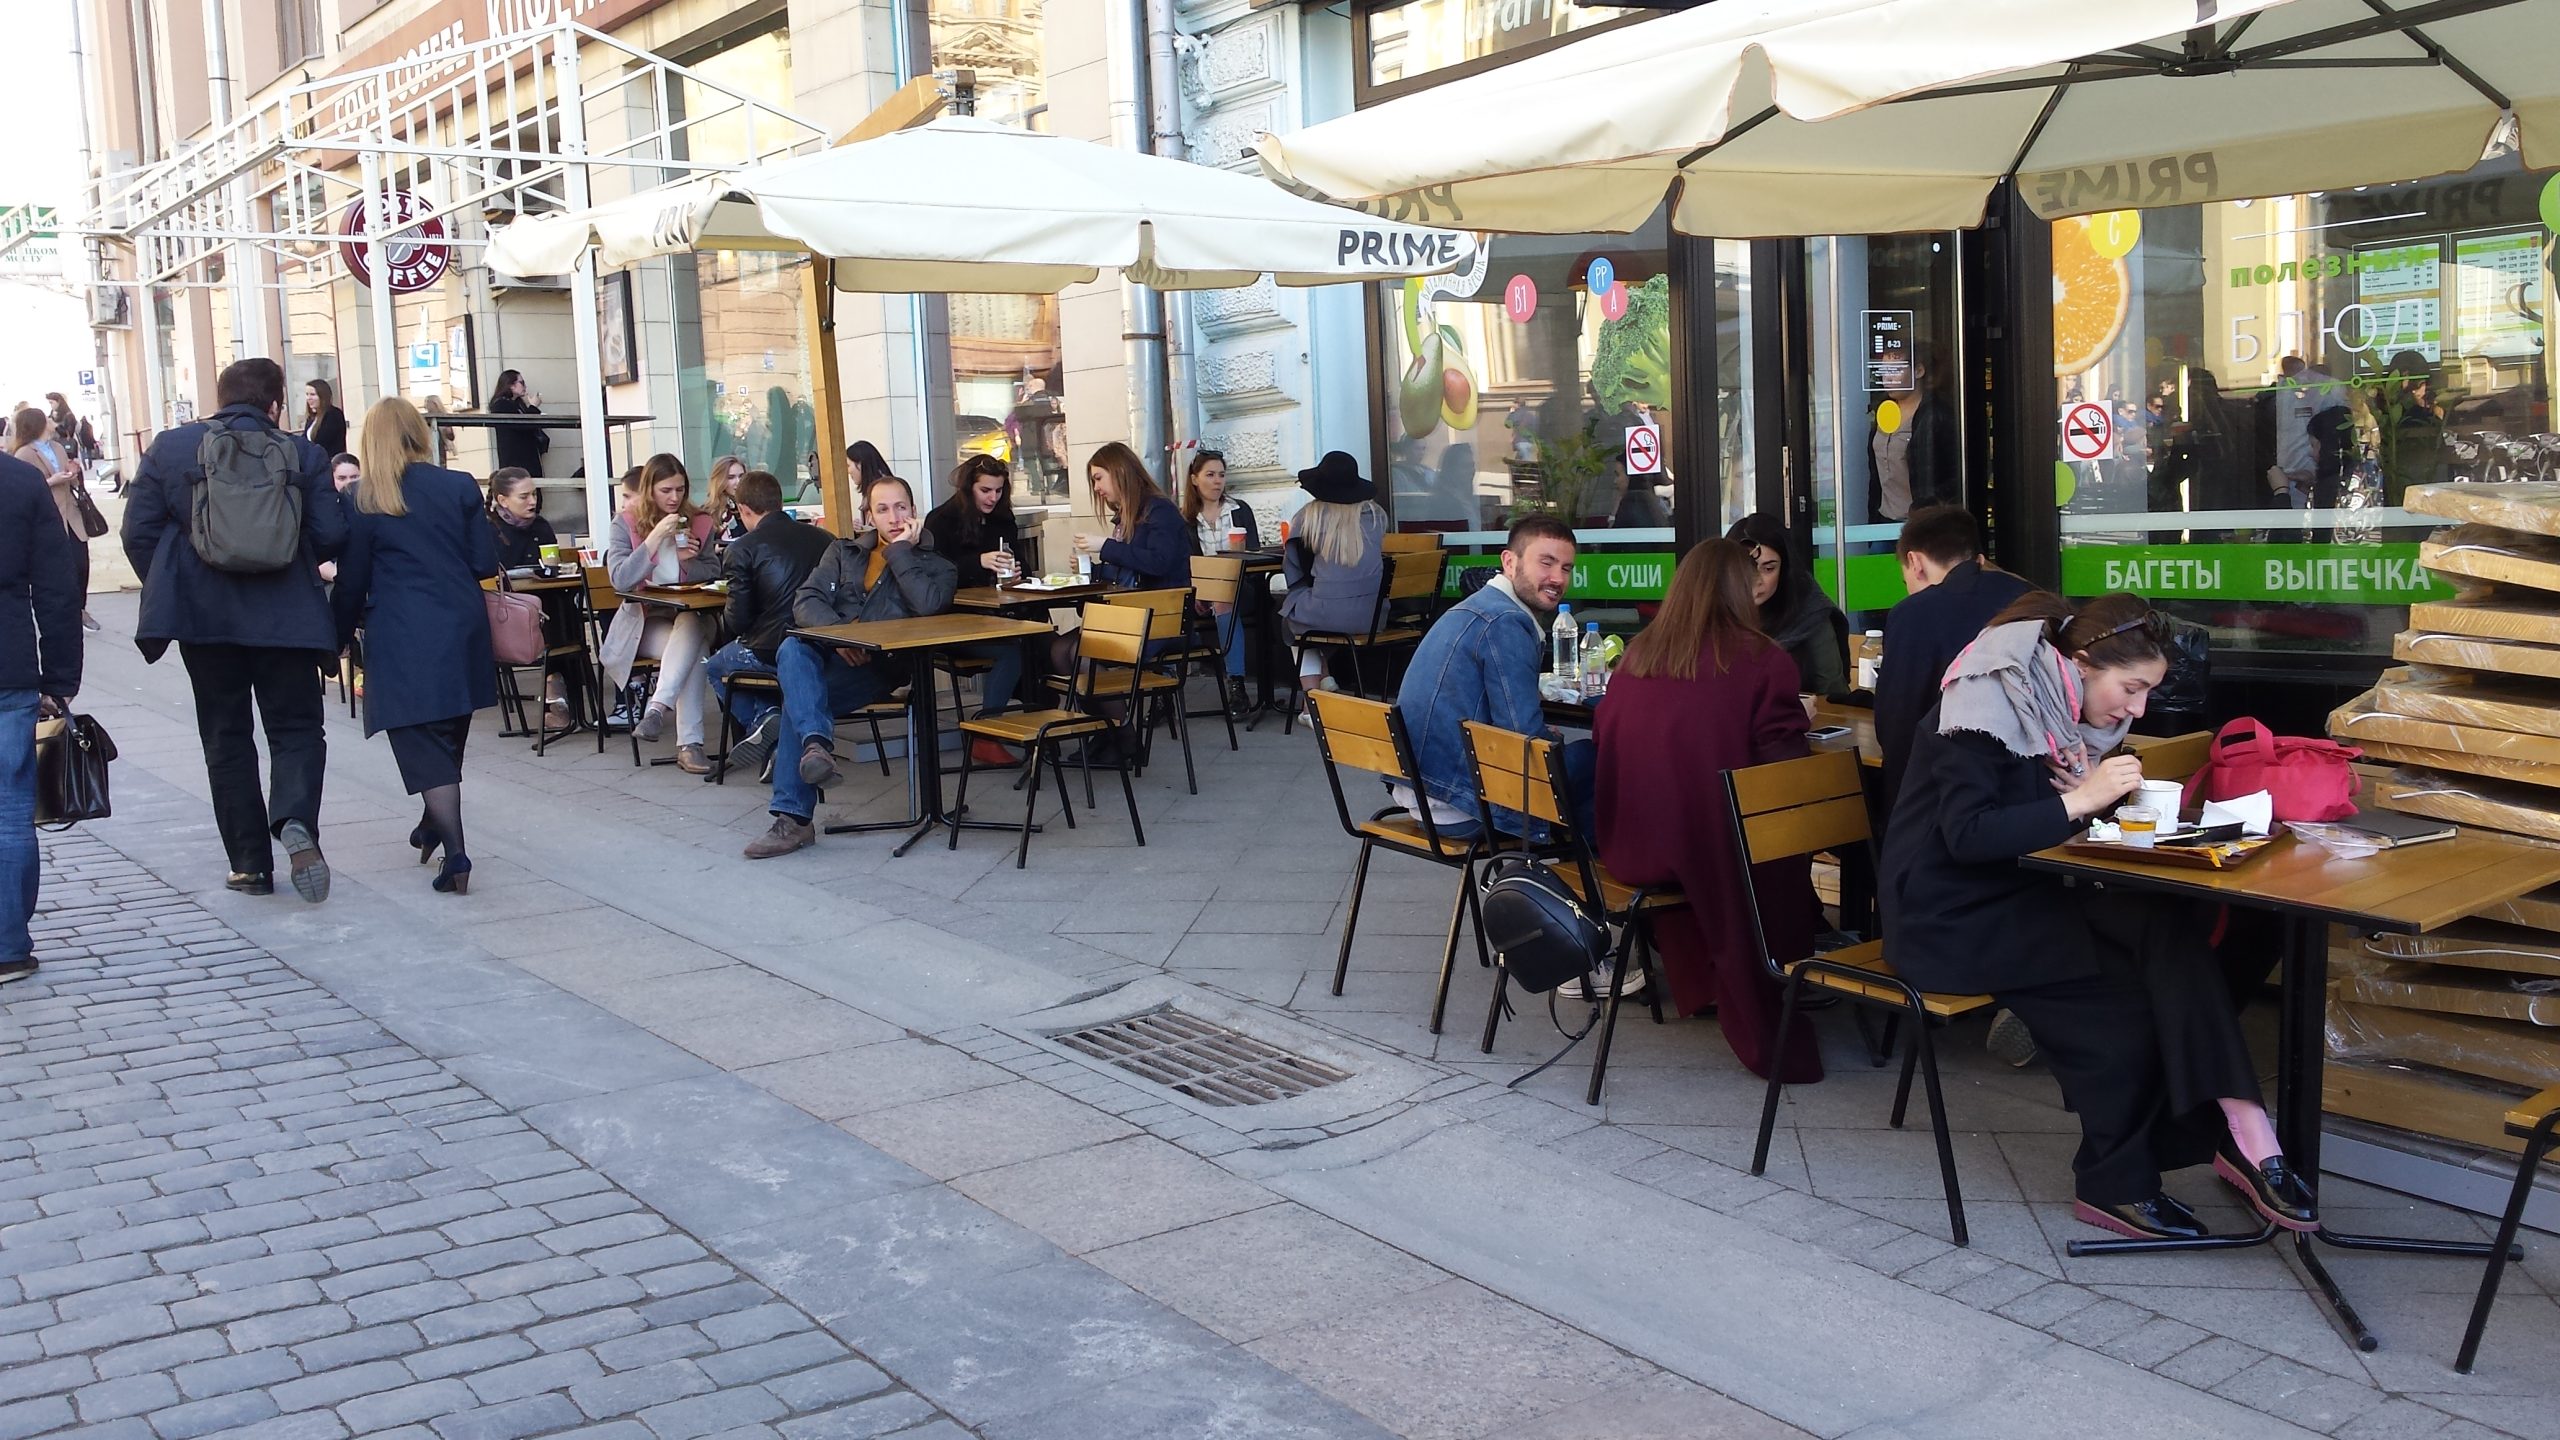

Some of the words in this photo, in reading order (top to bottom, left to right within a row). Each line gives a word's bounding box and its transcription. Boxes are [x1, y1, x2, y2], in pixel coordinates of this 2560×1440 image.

[1338, 229, 1461, 266] PRIME
[2230, 246, 2427, 290] полезных
[1877, 322, 1898, 331] PRIME
[2231, 298, 2429, 364] БЛЮД
[1606, 563, 1663, 588] СУШИ
[2104, 559, 2221, 590] БАГЕТЫ
[2264, 558, 2432, 591] ВЫПЕЧКА
